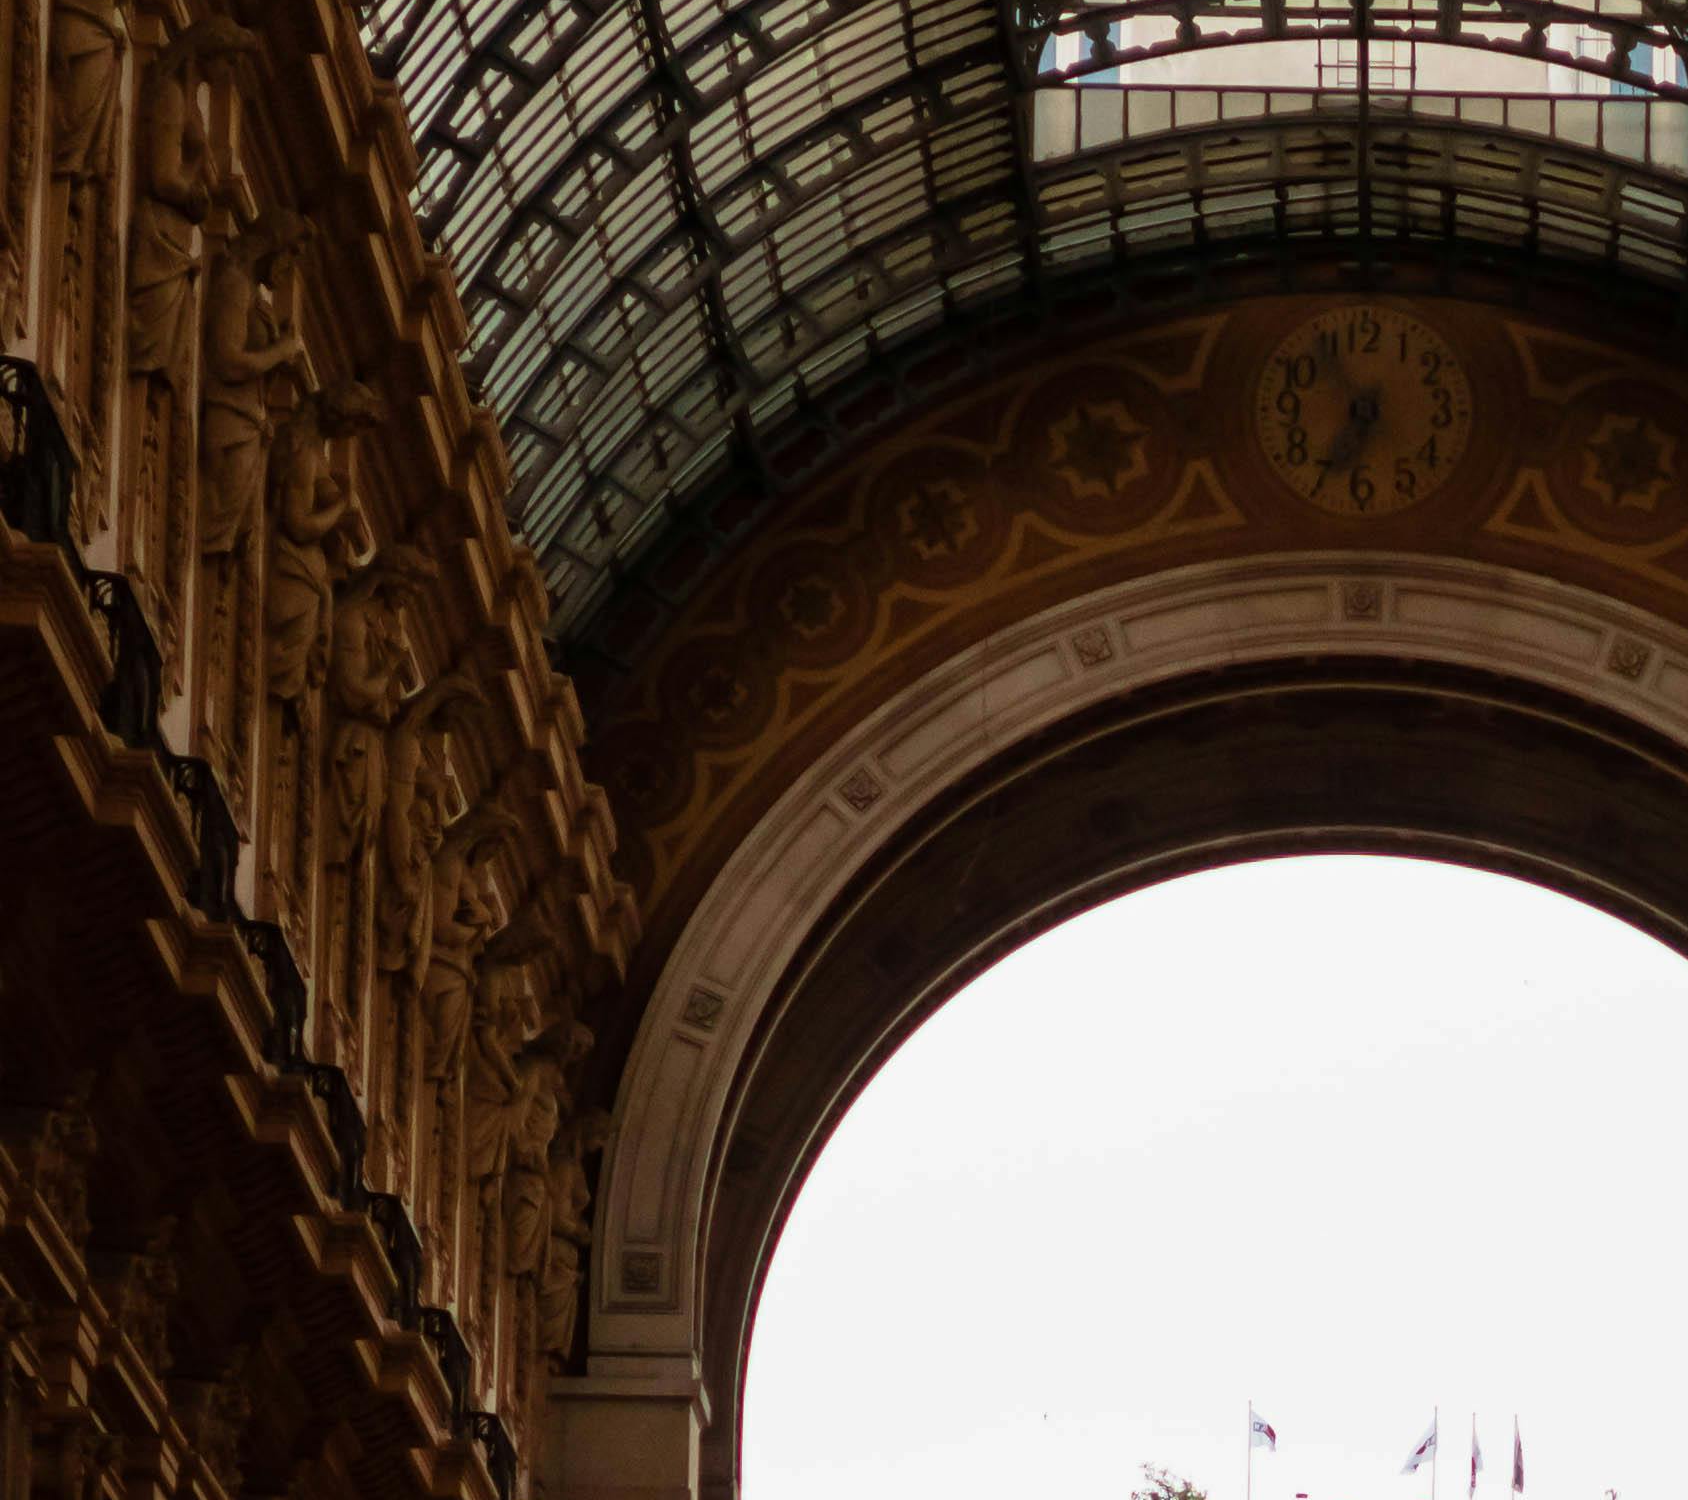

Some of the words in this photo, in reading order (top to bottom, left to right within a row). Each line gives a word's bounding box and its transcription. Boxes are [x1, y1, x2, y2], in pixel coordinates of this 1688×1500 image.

[1348, 320, 1382, 353] 12
[1398, 332, 1408, 364] 1
[1284, 355, 1317, 389] 10
[1420, 351, 1441, 387] 2
[1276, 390, 1301, 426] 9
[1431, 388, 1453, 428] 3
[1287, 427, 1309, 467] 8
[1417, 435, 1439, 470] 4
[1312, 459, 1334, 498] 7
[1350, 466, 1375, 505] 6
[1394, 457, 1417, 498] 5
